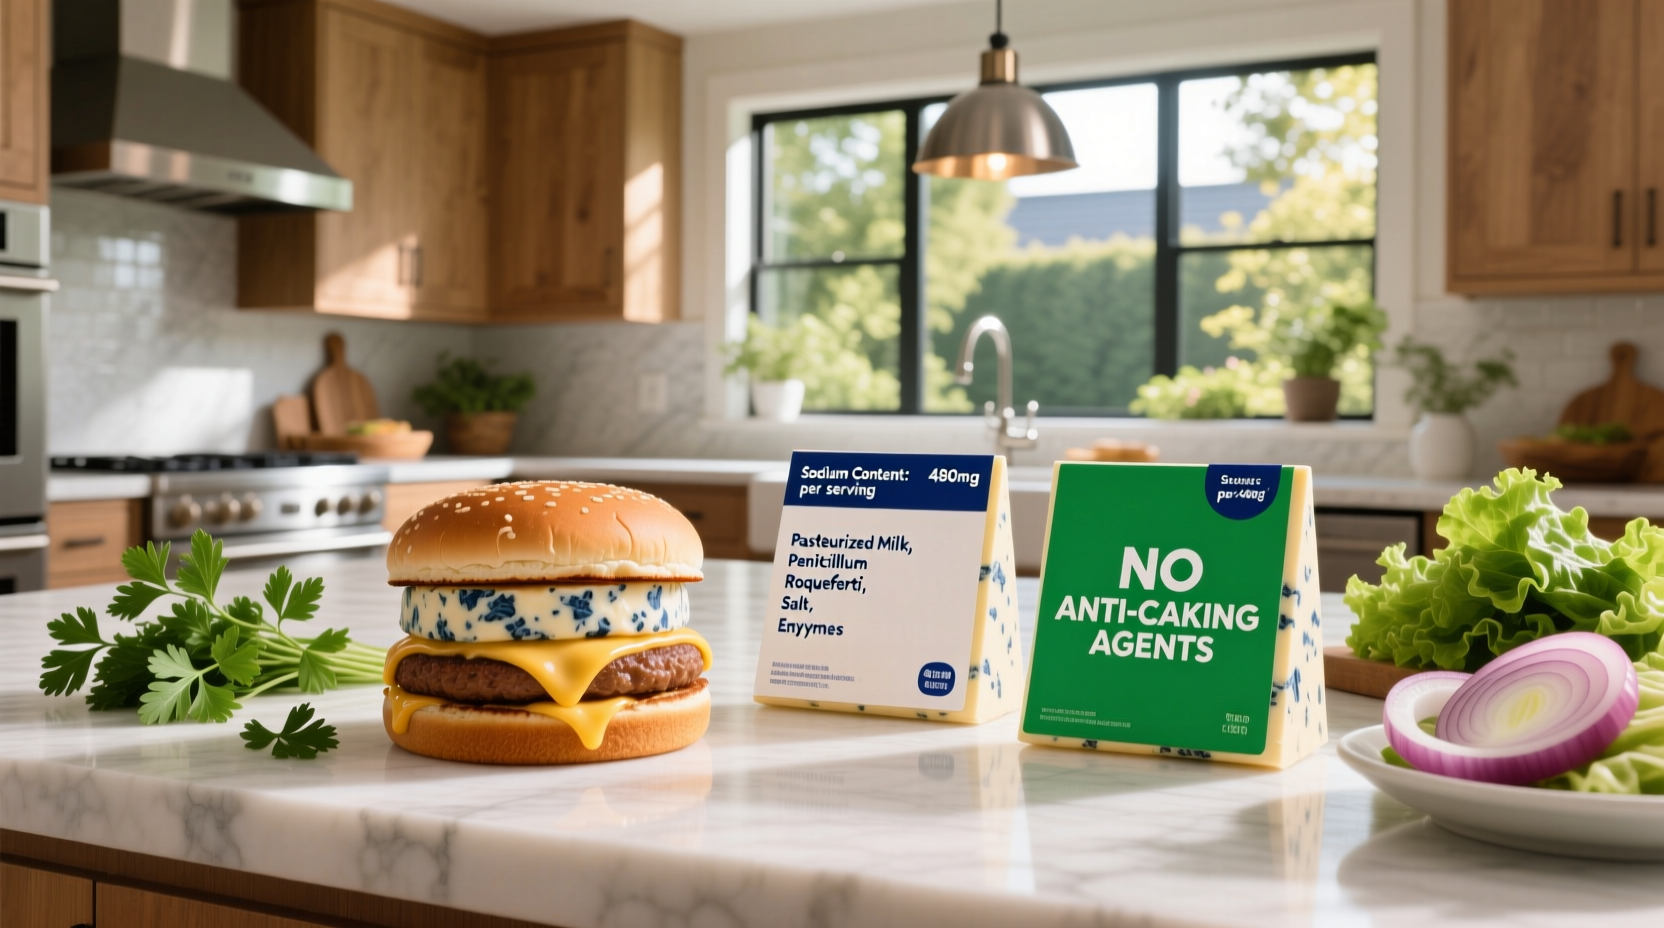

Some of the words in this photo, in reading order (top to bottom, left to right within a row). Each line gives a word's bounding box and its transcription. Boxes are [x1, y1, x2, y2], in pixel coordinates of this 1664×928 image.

[851, 467, 910, 482] Content:
[799, 484, 822, 499] per
[825, 481, 876, 500] serving
[791, 533, 875, 550] Pasteurized
[877, 535, 913, 555] Milk,
[1118, 546, 1204, 593] NO
[781, 595, 814, 613] Salt,
[1054, 595, 1260, 632] ANTI-CAKING
[1088, 629, 1215, 663] AGENTS
